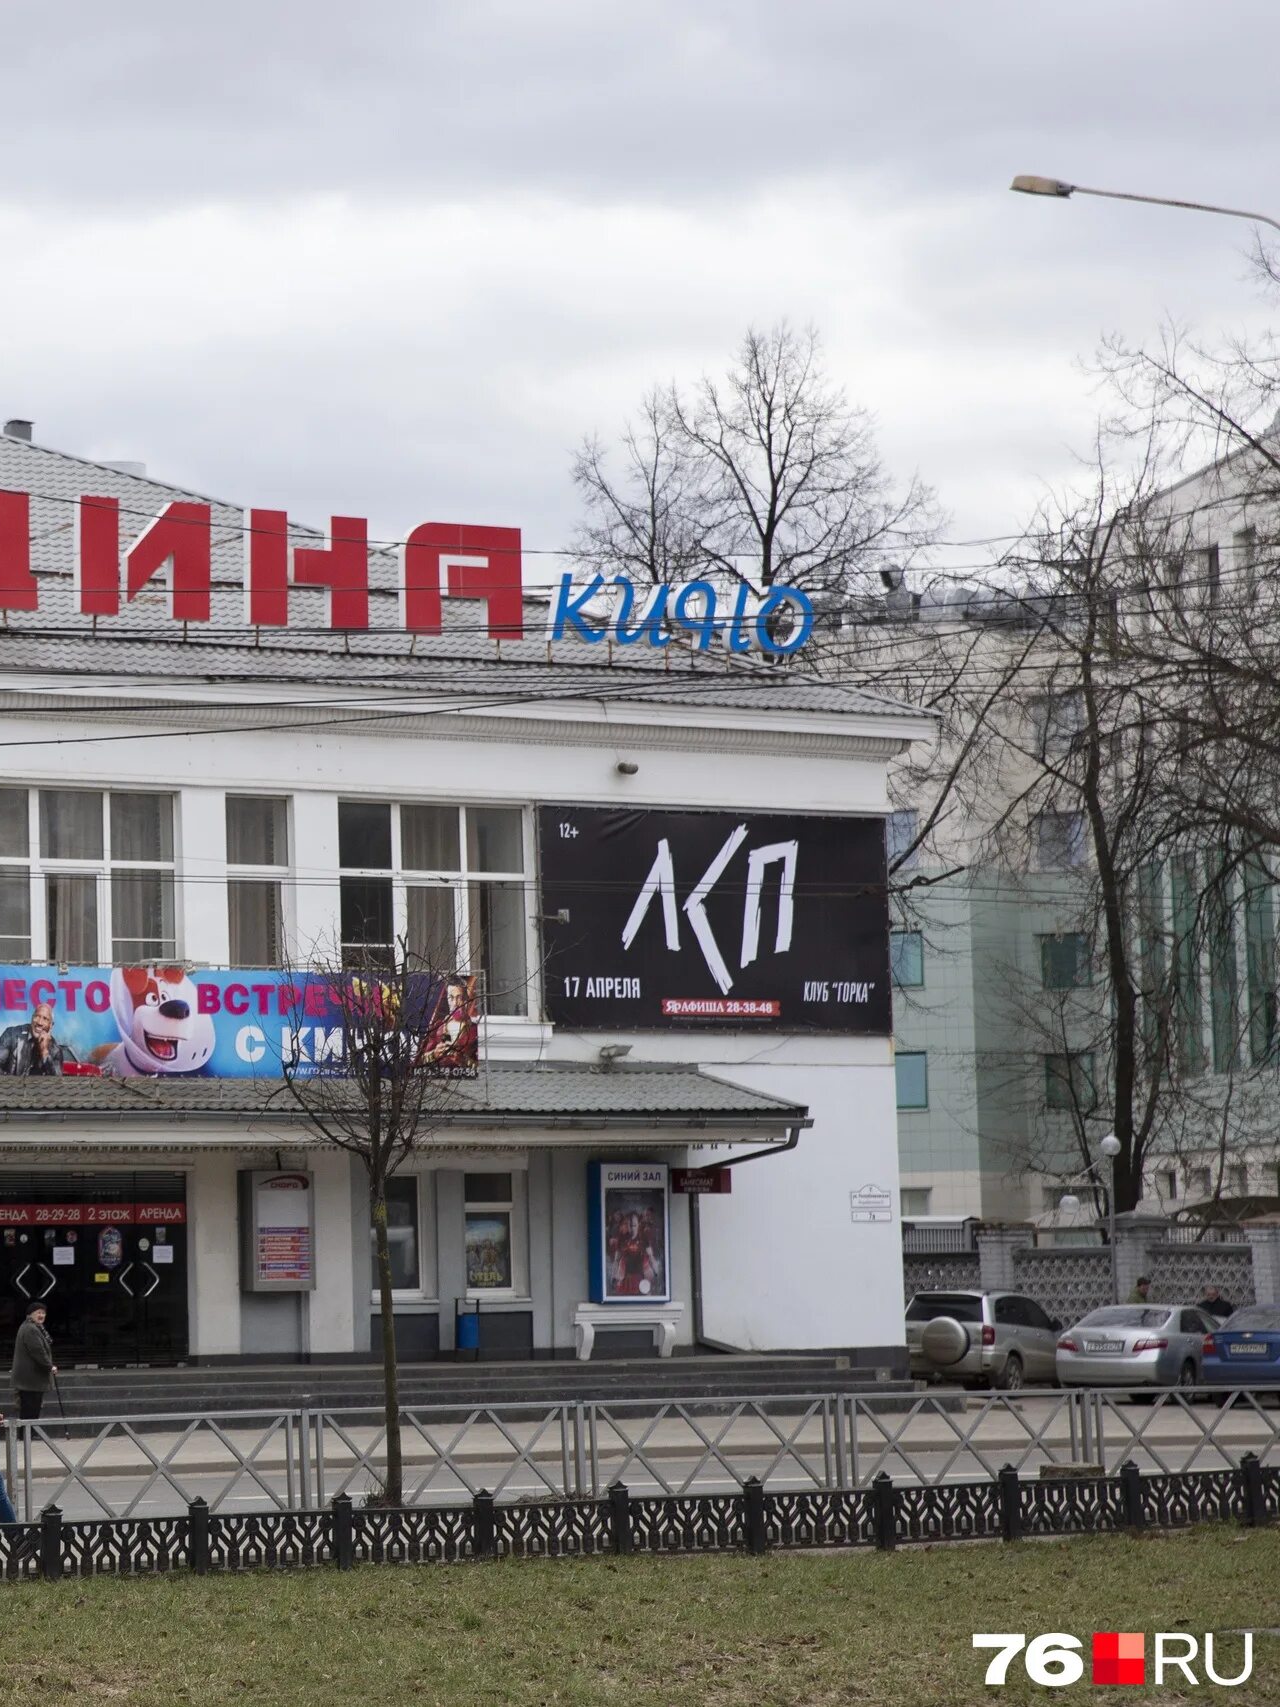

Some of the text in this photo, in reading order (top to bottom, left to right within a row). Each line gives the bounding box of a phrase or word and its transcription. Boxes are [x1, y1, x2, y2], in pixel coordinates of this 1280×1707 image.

[559, 823, 579, 839] 12+
[564, 977, 641, 999] 17 АПРЕЛЯ
[803, 981, 829, 1002] КЛУБ
[726, 1002, 773, 1014] 28-38-48
[235, 1025, 266, 1063] С
[607, 1169, 662, 1182] СИНИЙ ЗАЛ
[35, 1209, 81, 1221] 28-29-28
[88, 1208, 96, 1220] 2
[99, 1209, 130, 1221] этаж
[139, 1208, 181, 1219] АРЕНДА
